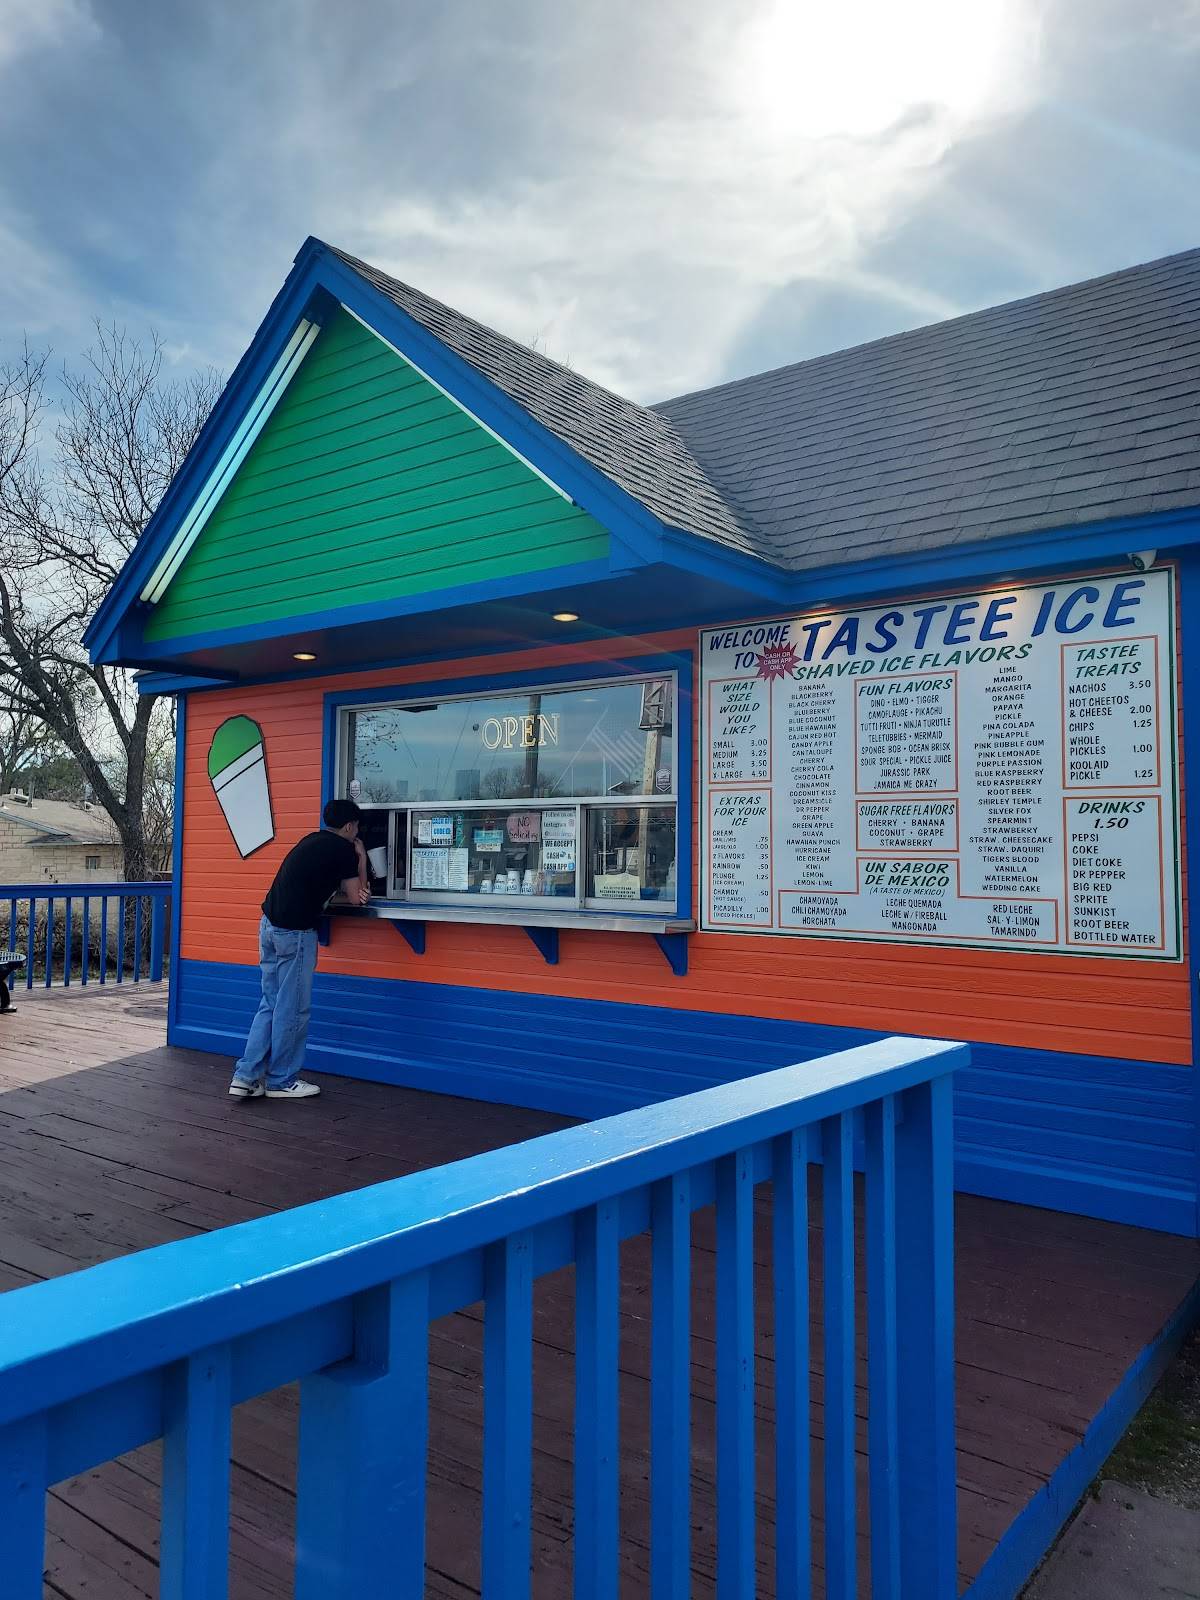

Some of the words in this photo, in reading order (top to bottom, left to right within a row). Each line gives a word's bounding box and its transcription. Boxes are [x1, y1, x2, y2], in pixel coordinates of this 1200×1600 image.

[802, 596, 1017, 661] TASTEE
[1031, 580, 1146, 637] ICE
[710, 625, 790, 650] WELCOME
[1077, 644, 1140, 661] TASTEE
[735, 652, 755, 670] TO
[793, 659, 875, 680] SHAVED
[879, 655, 916, 673] ICE
[919, 643, 1033, 668] FLAVORS
[1076, 662, 1142, 678] TREATS
[994, 675, 1022, 683] MANGO
[722, 681, 756, 692] WHAT
[859, 685, 885, 696] FUN
[888, 679, 953, 694] FLAVORS
[985, 684, 1032, 693] MARGARITA
[1069, 683, 1106, 694] NACHOS
[1129, 680, 1151, 689] 3.50
[727, 693, 752, 702] SIZE
[792, 691, 833, 700] BLACKBERRY
[871, 699, 885, 707] DINO
[892, 697, 908, 706] ELMO
[916, 695, 939, 704] TIGGER
[1070, 698, 1086, 708] HOT
[1089, 696, 1129, 706] CHEETOS
[720, 703, 760, 713] WOULD
[869, 709, 908, 719] CAMOFLAUGE
[916, 707, 943, 716] PIKACHU
[1070, 709, 1076, 718] &
[1080, 707, 1112, 717] CHEESE
[1130, 705, 1151, 714] 2.00
[728, 715, 751, 724] YOU
[861, 723, 877, 731] TUTTI
[880, 722, 896, 730] FRUTI
[904, 720, 921, 728] NINJA
[923, 718, 951, 727] TURUTLE
[723, 725, 756, 735] LIKE?
[1003, 721, 1034, 729] COLADA
[1069, 722, 1094, 732] CHIPS
[1134, 719, 1152, 728] 1.25
[481, 713, 560, 749] OPEN
[988, 731, 1029, 739] PINEAPPLE
[869, 733, 906, 742] TELETUBBIES
[915, 731, 943, 740] MERMAID
[1070, 736, 1100, 745] WHOLE
[862, 746, 885, 754] SPONGE
[888, 745, 901, 753] BOB
[909, 744, 929, 752] OCEAN
[932, 743, 950, 751] BRISK
[1070, 746, 1106, 756] PICKLES
[1133, 744, 1152, 752] 1.00
[713, 761, 735, 769] LARGE
[861, 758, 876, 766] SOUR
[879, 757, 902, 765] SPECIAL
[910, 756, 931, 764] PICKLE
[934, 755, 951, 764] JUICE
[880, 769, 910, 777] JURASSIC
[914, 768, 930, 776] PARK
[1070, 771, 1101, 780] PICKLE
[1135, 770, 1153, 778] 1.25
[874, 781, 900, 789] JAMAICA
[904, 780, 912, 788] ME
[916, 779, 937, 788] CRAZY
[720, 796, 761, 805] EXTRAS
[714, 808, 735, 816] FOR
[859, 806, 888, 816] SUGAR
[890, 805, 912, 816] FREE
[913, 804, 955, 816] FLAVORS
[1078, 802, 1146, 814] DRINKS
[732, 818, 748, 826] ICE
[1094, 818, 1129, 828] 1.50
[1072, 834, 1099, 842] PEPSI
[1073, 846, 1099, 854] COKE
[1073, 858, 1093, 866] DIET
[1095, 858, 1122, 867] COKE
[865, 862, 886, 873] UN
[890, 863, 949, 874] SABOR
[1073, 871, 1085, 879] DR
[1089, 871, 1126, 879] PEPPER
[865, 875, 884, 885] DE
[888, 876, 950, 887] MEXICO
[1073, 883, 1090, 891] BIG
[800, 896, 838, 905] CHAMOYADA
[887, 899, 906, 907] LECHE
[908, 899, 942, 908] QUEMADA
[1074, 895, 1108, 904] SPRITE
[993, 905, 1007, 913] RED
[1010, 905, 1032, 914] LECHE
[1074, 907, 1116, 916] SUNKIST
[802, 917, 836, 926] HORCHATA
[892, 922, 936, 931] MANGONADA
[1074, 920, 1101, 928] ROOT
[1105, 920, 1129, 930] BEER
[991, 927, 1037, 937] TAMARINDO
[1074, 932, 1118, 941] BOTTLED
[1121, 934, 1156, 943] WATER
